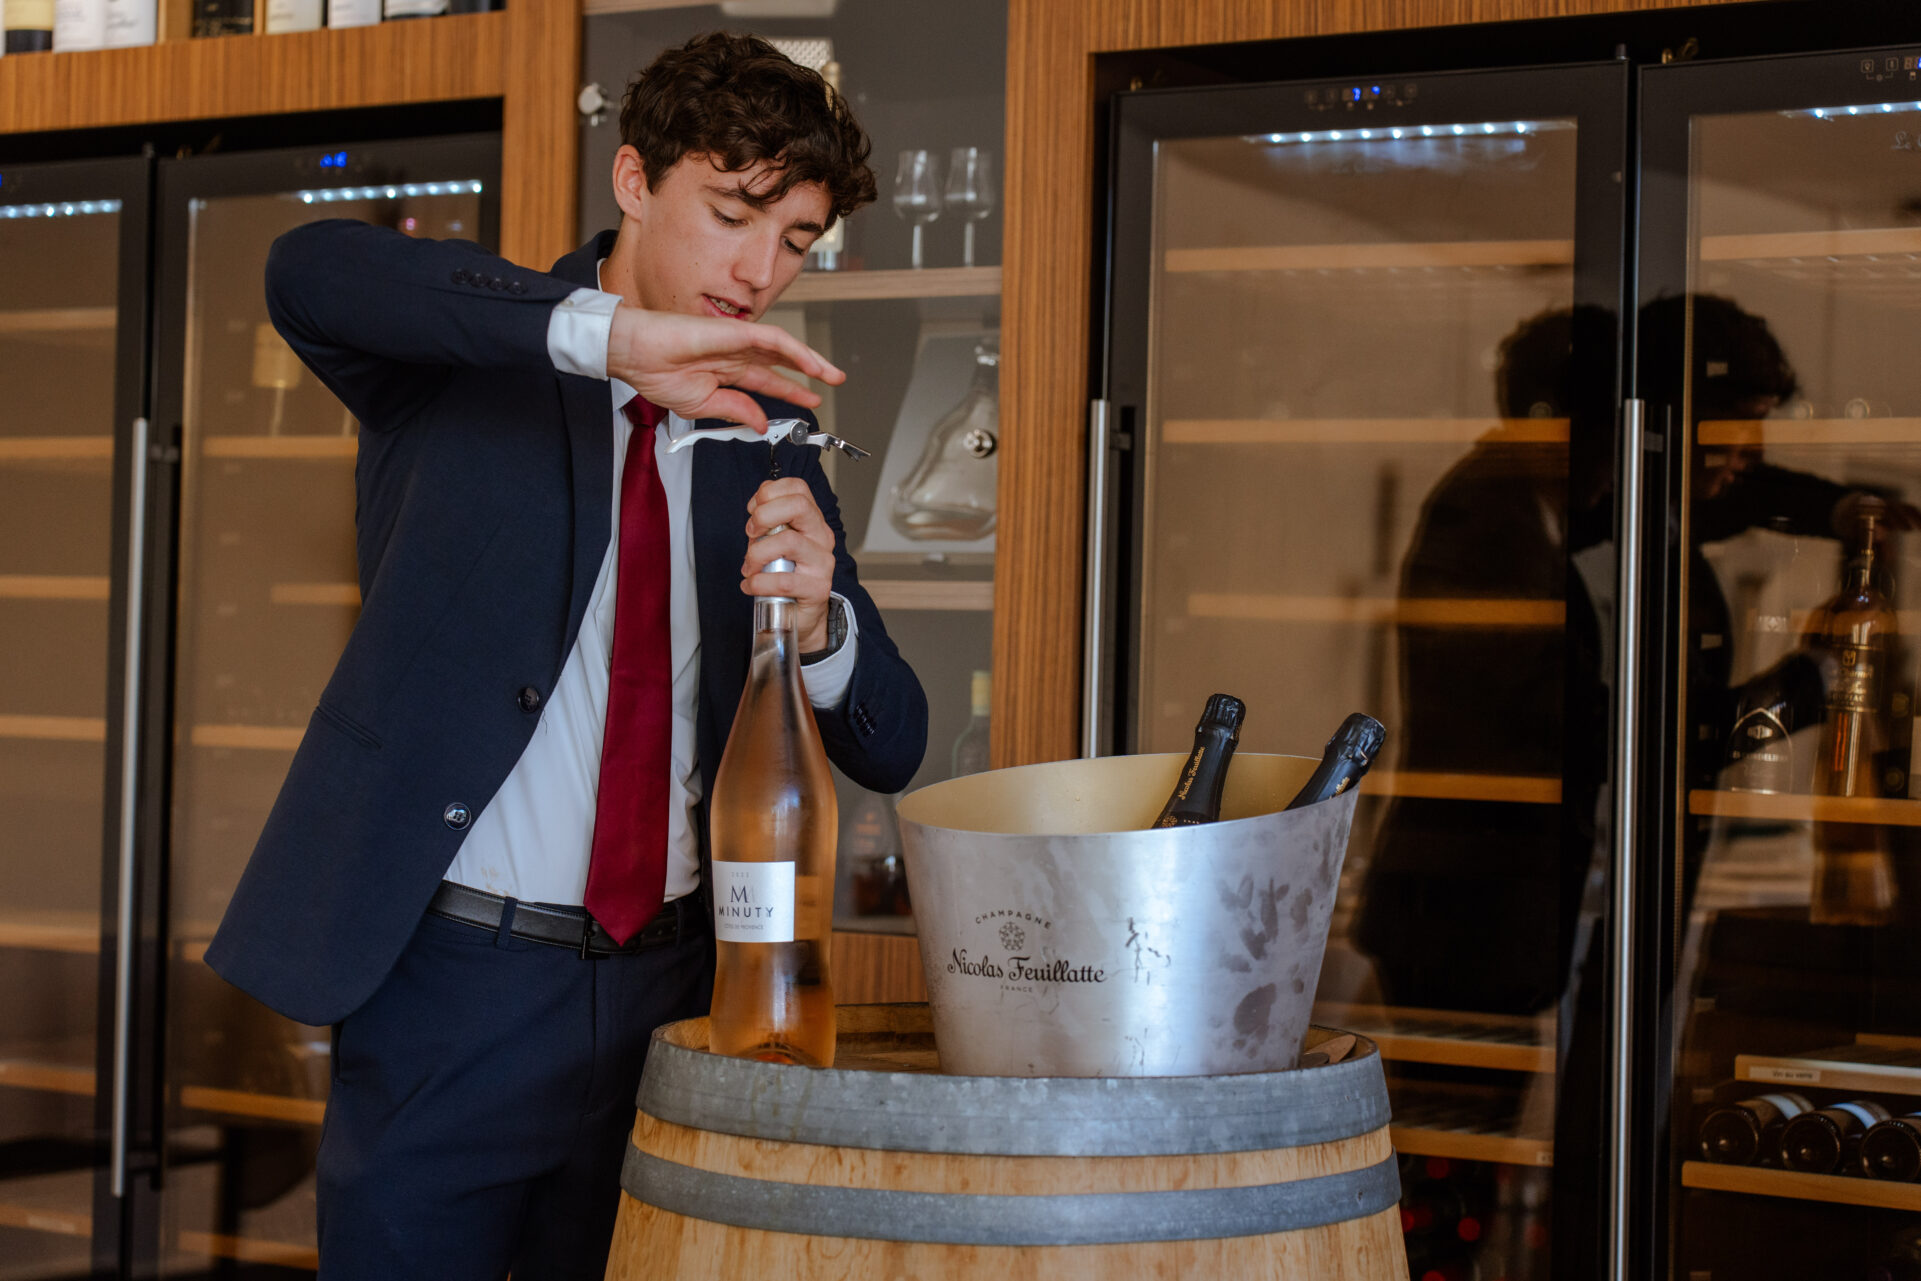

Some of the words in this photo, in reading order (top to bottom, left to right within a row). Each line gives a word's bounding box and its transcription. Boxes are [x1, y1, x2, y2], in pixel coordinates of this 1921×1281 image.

[730, 885, 749, 903] M
[719, 906, 774, 918] MINUTY
[976, 909, 1052, 930] CHAMPAGNE
[947, 947, 1004, 978] Nicolas
[1007, 956, 1107, 984] Feuillatte
[1000, 985, 1033, 993] FRANCE
